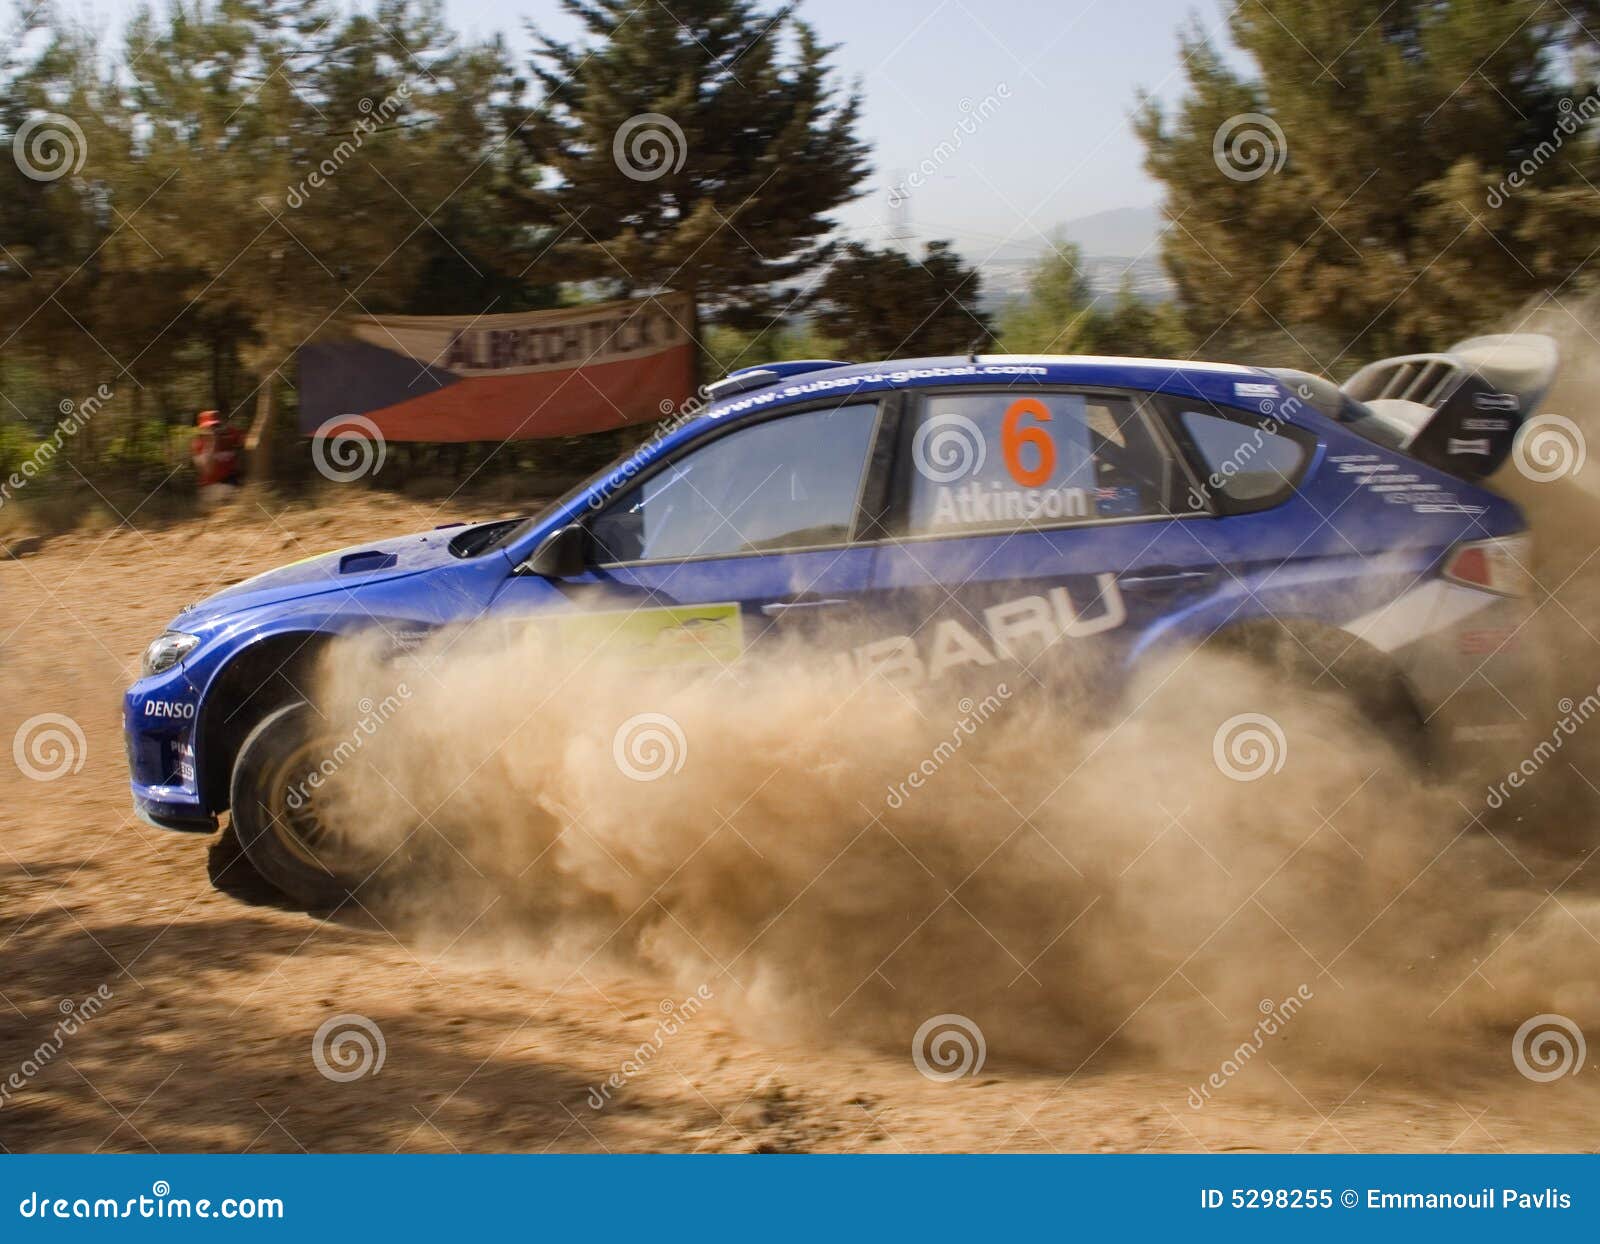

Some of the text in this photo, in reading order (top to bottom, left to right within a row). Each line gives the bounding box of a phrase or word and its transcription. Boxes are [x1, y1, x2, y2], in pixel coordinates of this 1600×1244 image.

[708, 365, 1047, 420] www.subaru-global.com
[1002, 397, 1057, 488] 6
[933, 482, 1089, 523] Atkinson
[144, 699, 195, 719] DENSO
